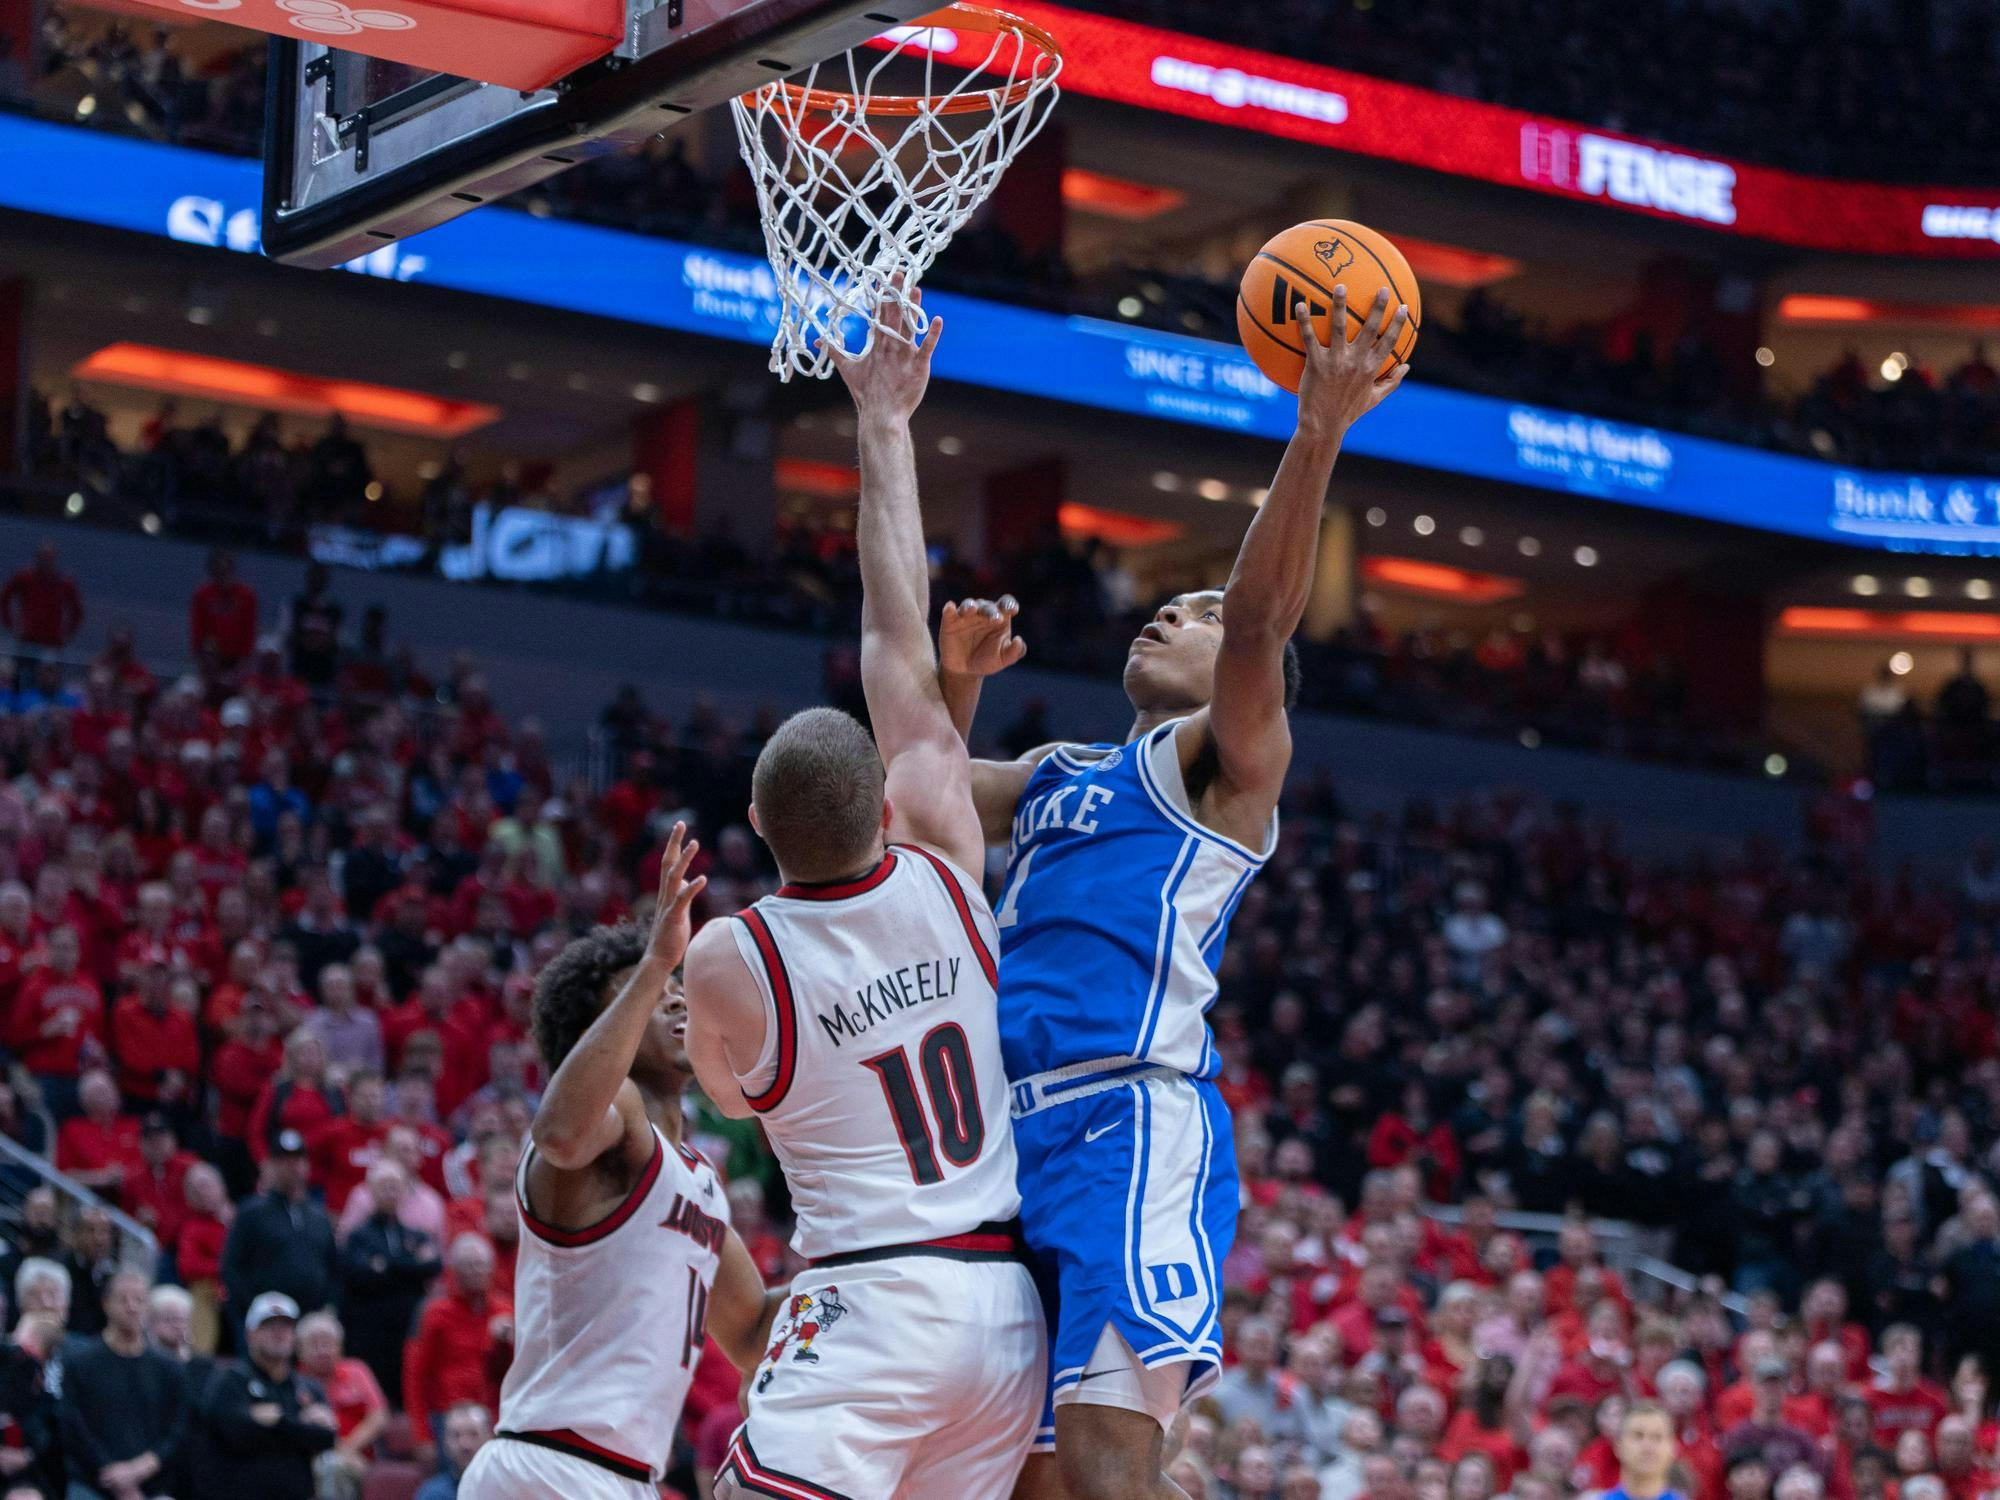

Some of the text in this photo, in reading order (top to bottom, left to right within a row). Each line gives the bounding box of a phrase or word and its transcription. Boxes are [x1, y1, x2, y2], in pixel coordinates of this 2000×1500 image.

[818, 957, 960, 1047] McKNEELY
[858, 1021, 985, 1186] 10
[1145, 1262, 1198, 1304] D
